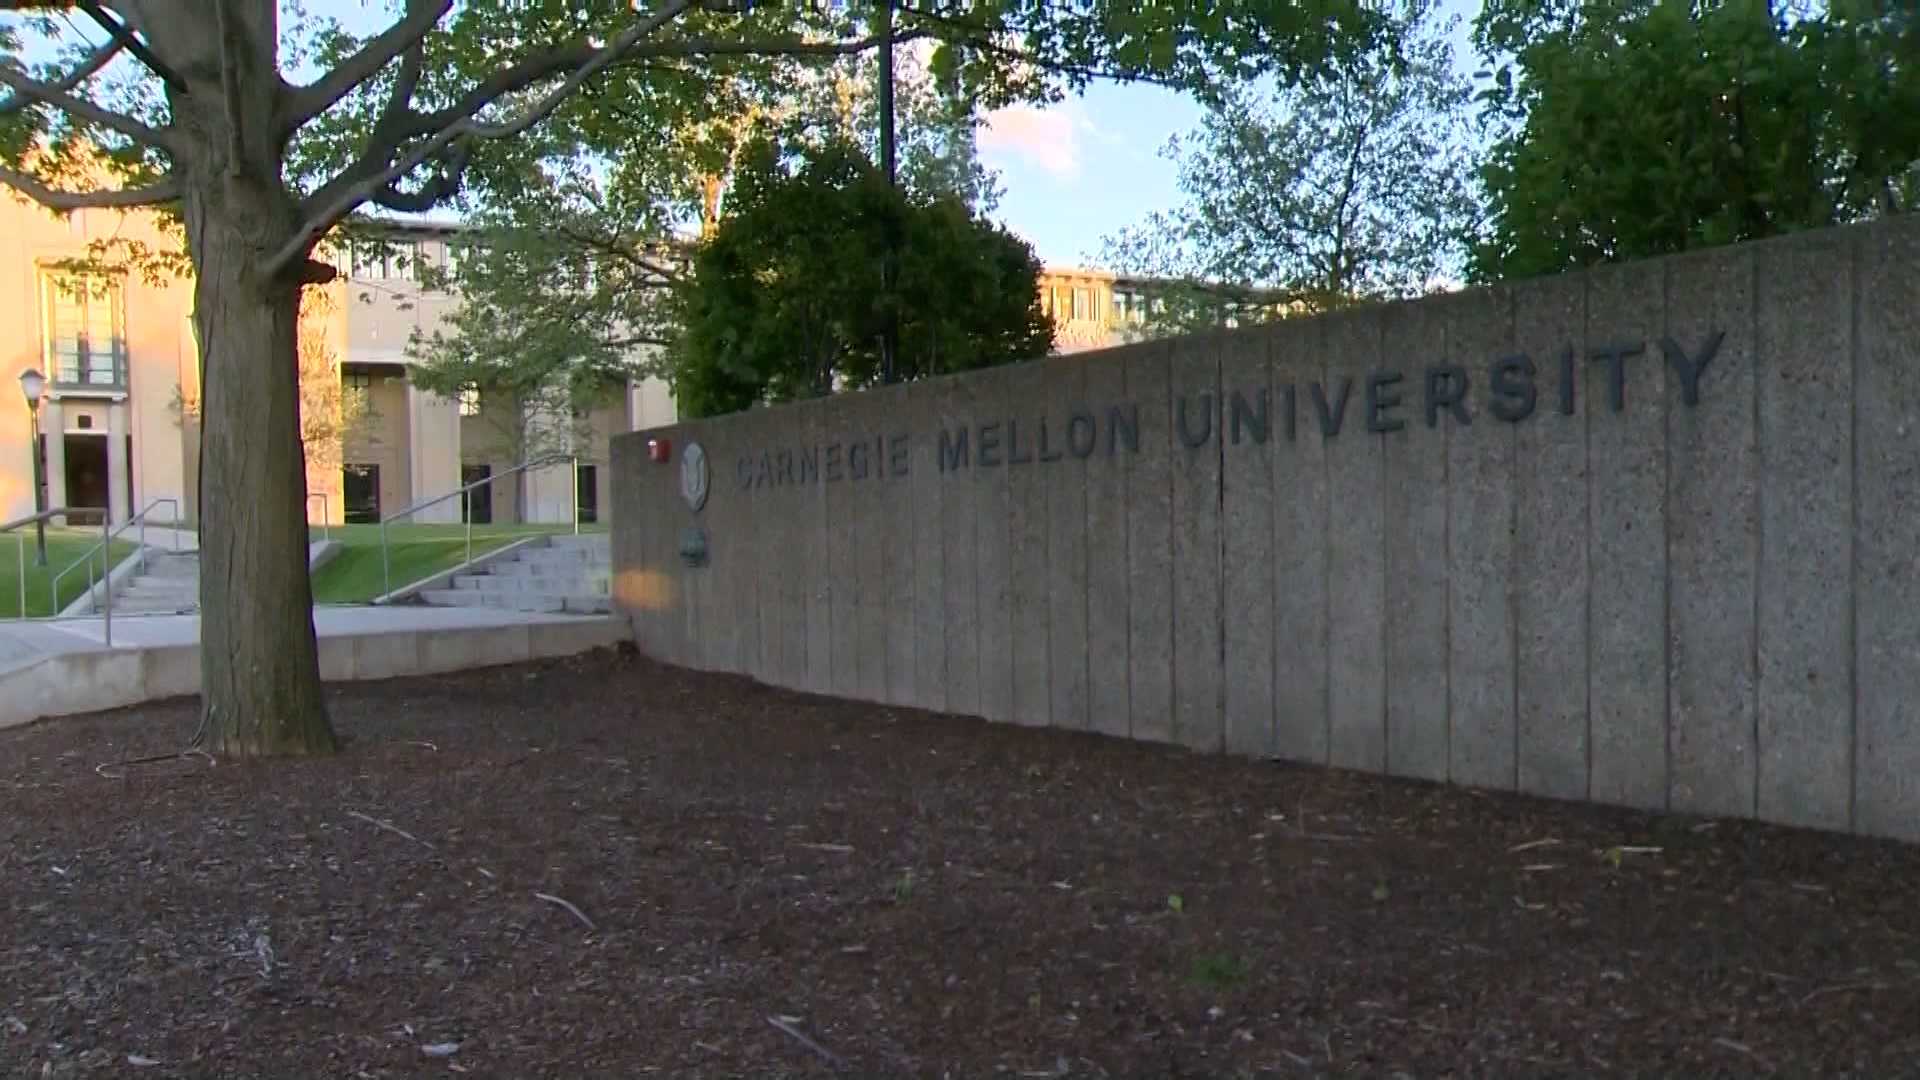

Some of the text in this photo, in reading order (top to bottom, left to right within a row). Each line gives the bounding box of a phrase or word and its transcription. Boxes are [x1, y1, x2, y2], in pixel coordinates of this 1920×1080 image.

[737, 331, 1726, 490] CARNEGIE MELLON UNIVERSITY
